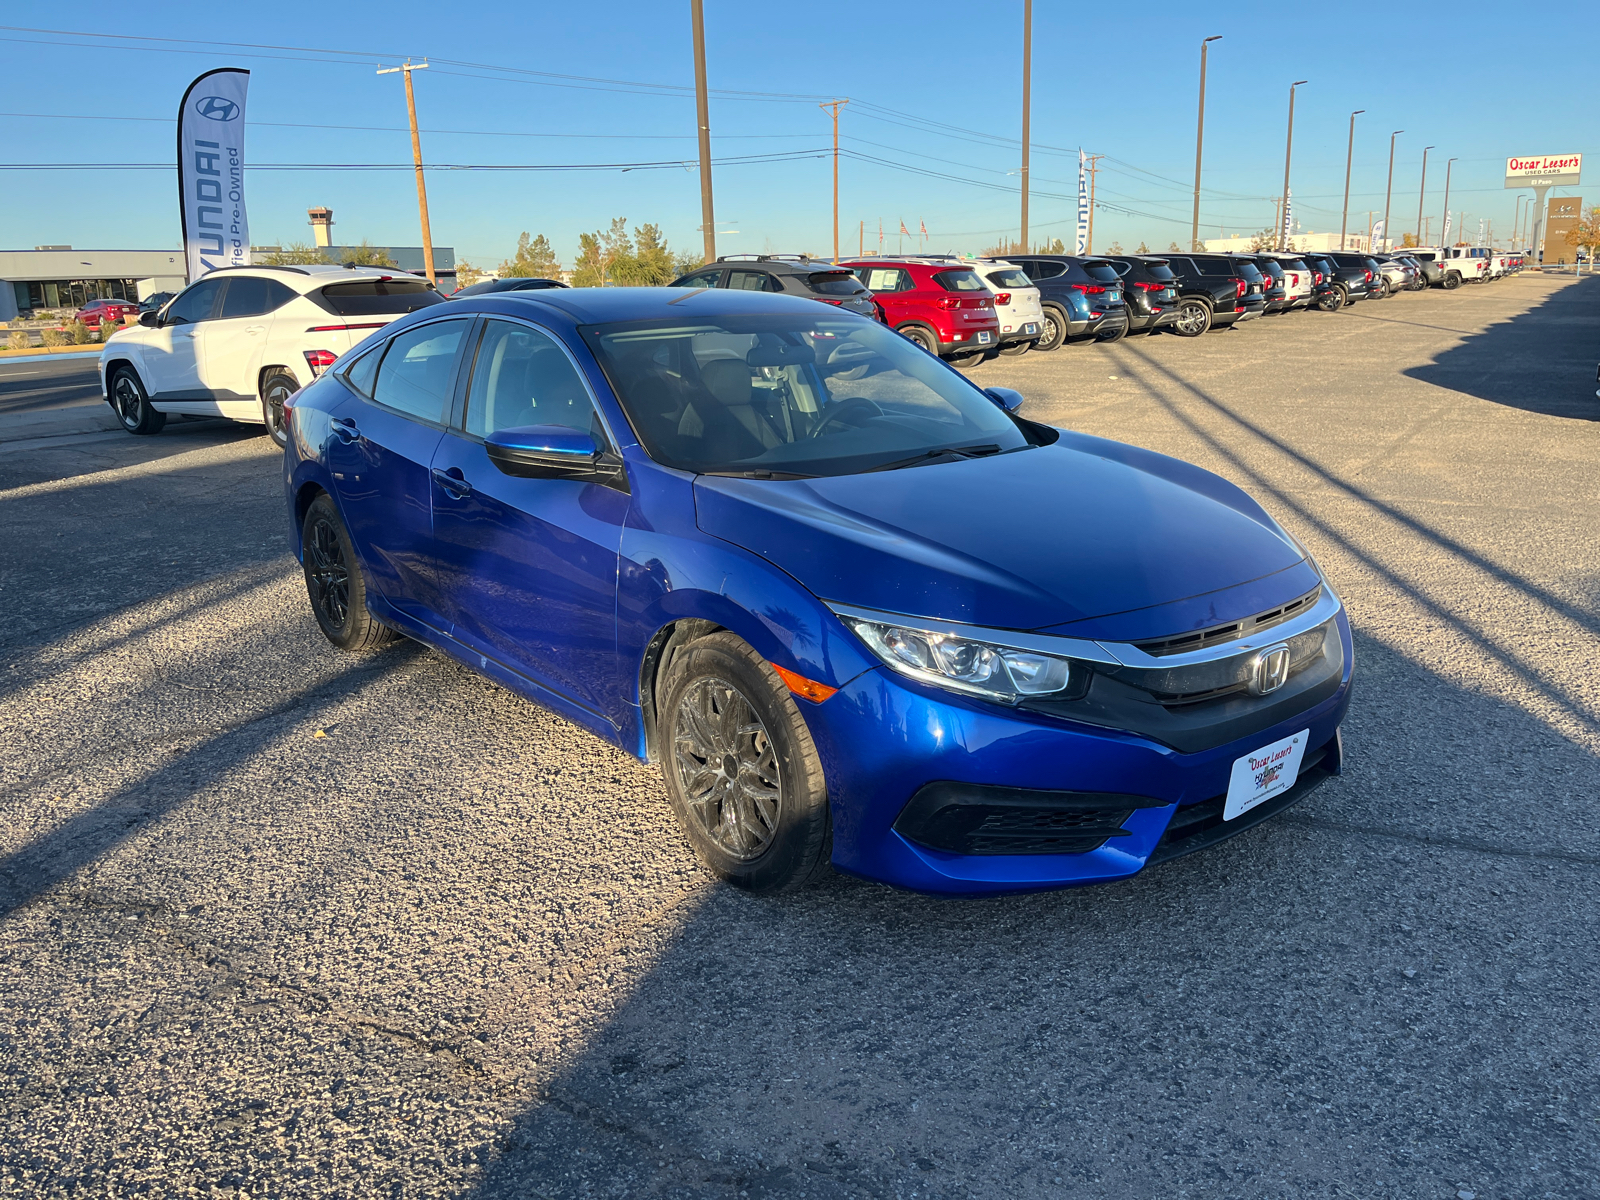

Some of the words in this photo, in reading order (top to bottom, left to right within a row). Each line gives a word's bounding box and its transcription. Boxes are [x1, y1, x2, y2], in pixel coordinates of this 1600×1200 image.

[1509, 158, 1540, 170] Oscar
[1542, 156, 1579, 169] Leeser's
[226, 147, 241, 235] Pre-Owned
[1251, 756, 1270, 771] Oscar
